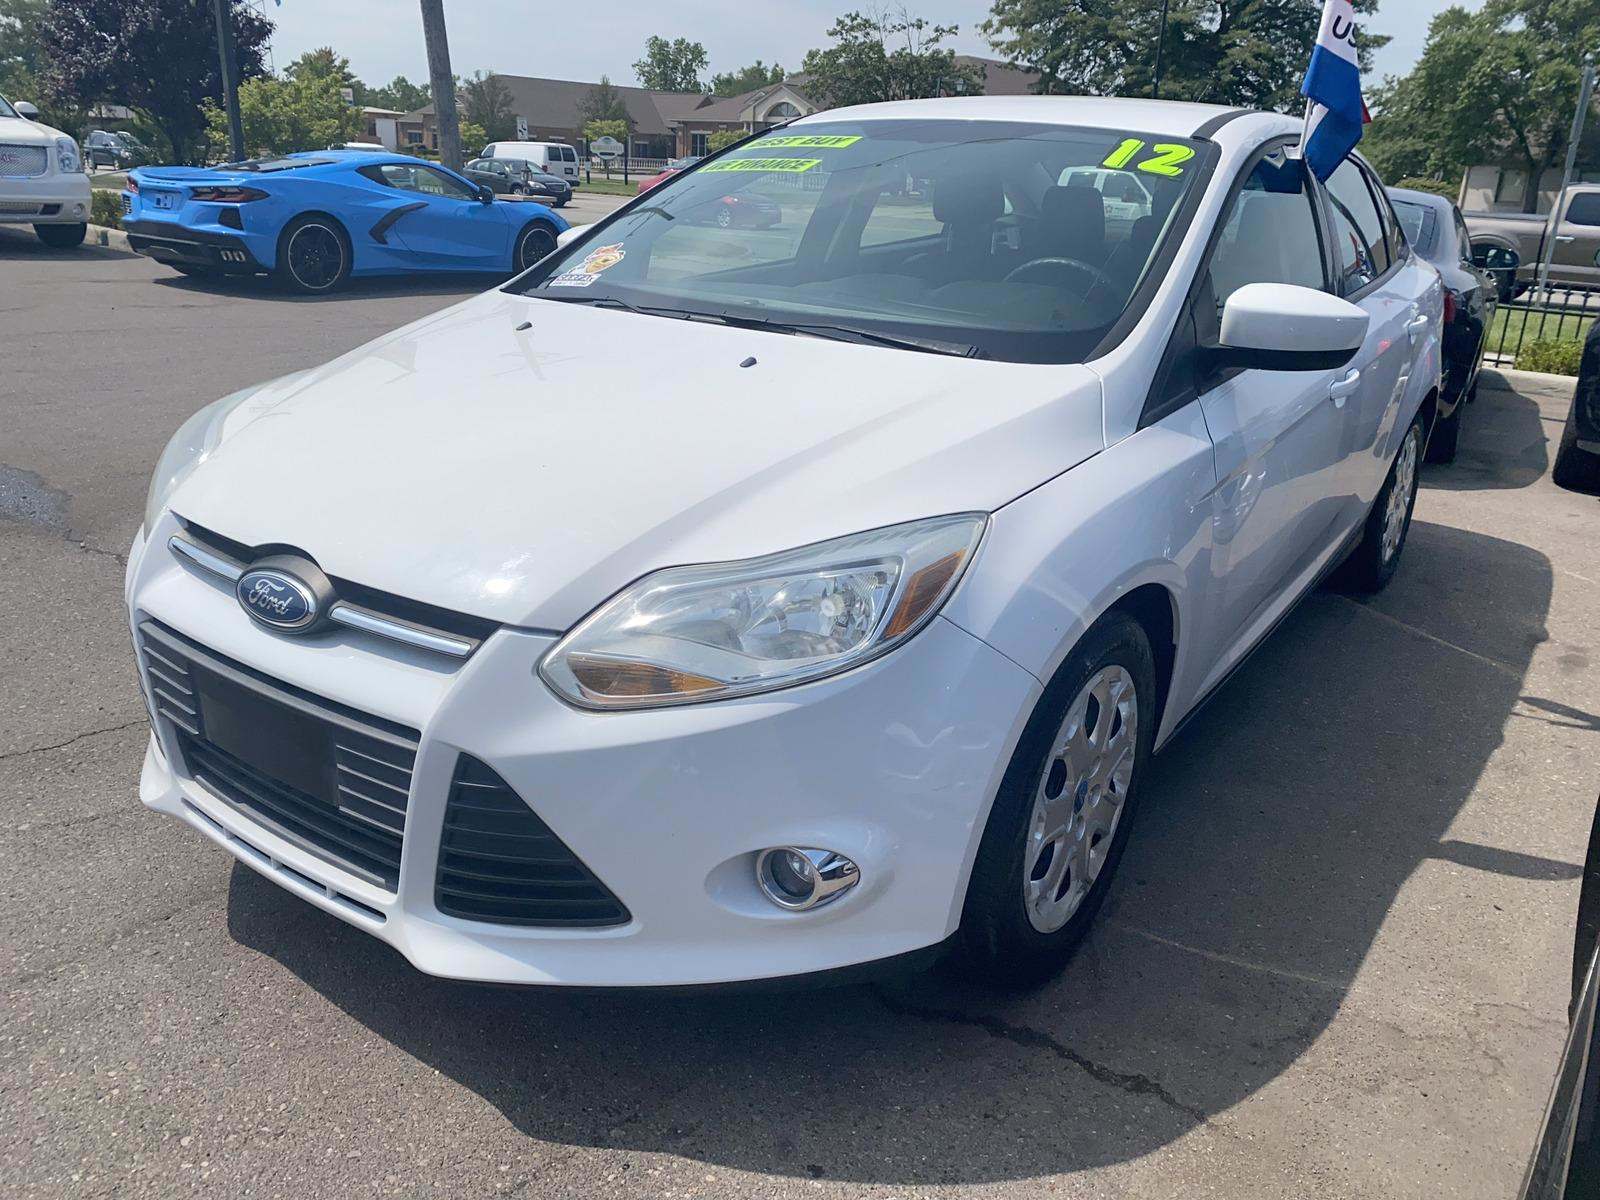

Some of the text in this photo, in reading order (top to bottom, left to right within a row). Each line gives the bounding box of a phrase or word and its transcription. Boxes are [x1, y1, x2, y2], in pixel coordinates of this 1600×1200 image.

[799, 136, 847, 147] BUY
[1102, 138, 1196, 177] 12
[248, 578, 293, 615] Ford
